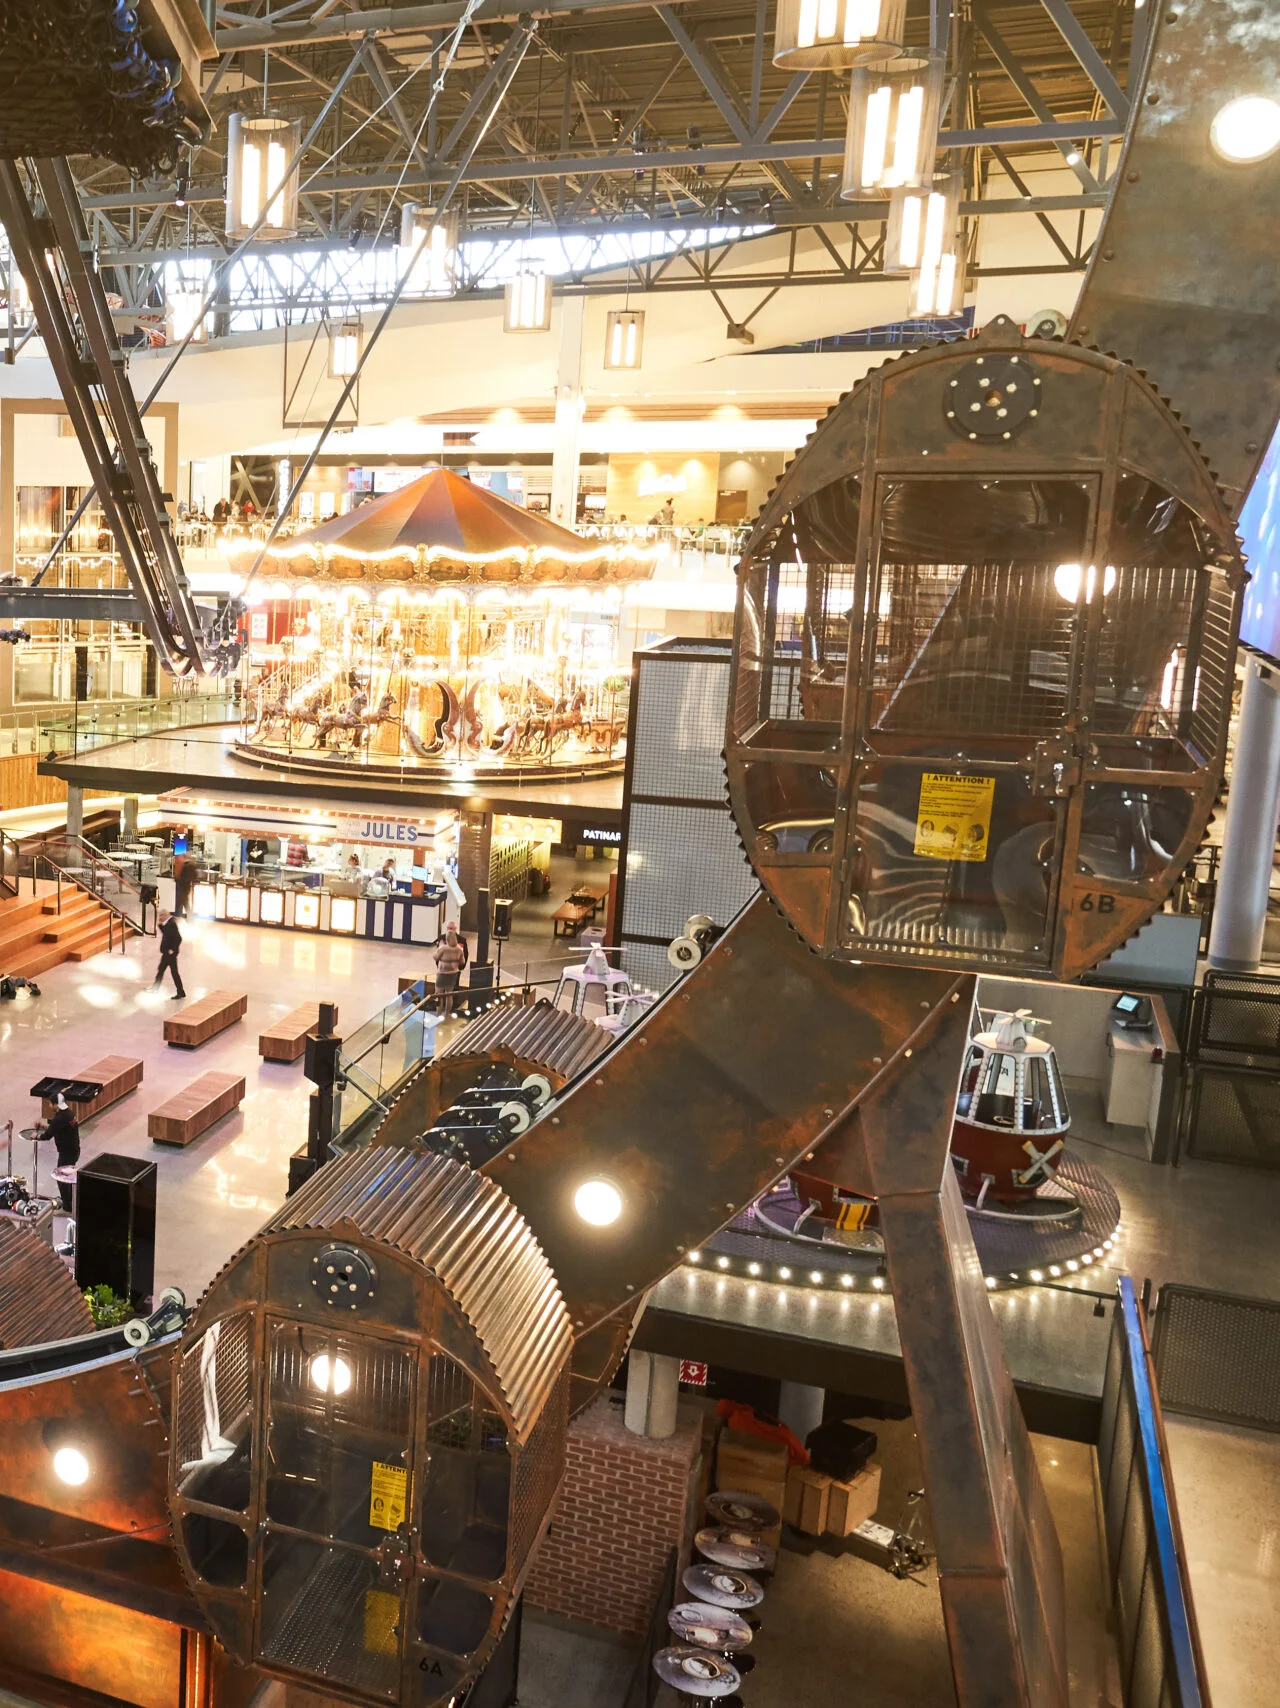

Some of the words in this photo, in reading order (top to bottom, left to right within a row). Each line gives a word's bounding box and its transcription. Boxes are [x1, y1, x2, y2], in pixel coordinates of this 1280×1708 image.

[933, 776, 984, 784] ATTENTION
[361, 822, 418, 842] JULES
[1079, 893, 1116, 914] 6B
[380, 1464, 407, 1474] ATTENT
[419, 1657, 444, 1677] 6A
